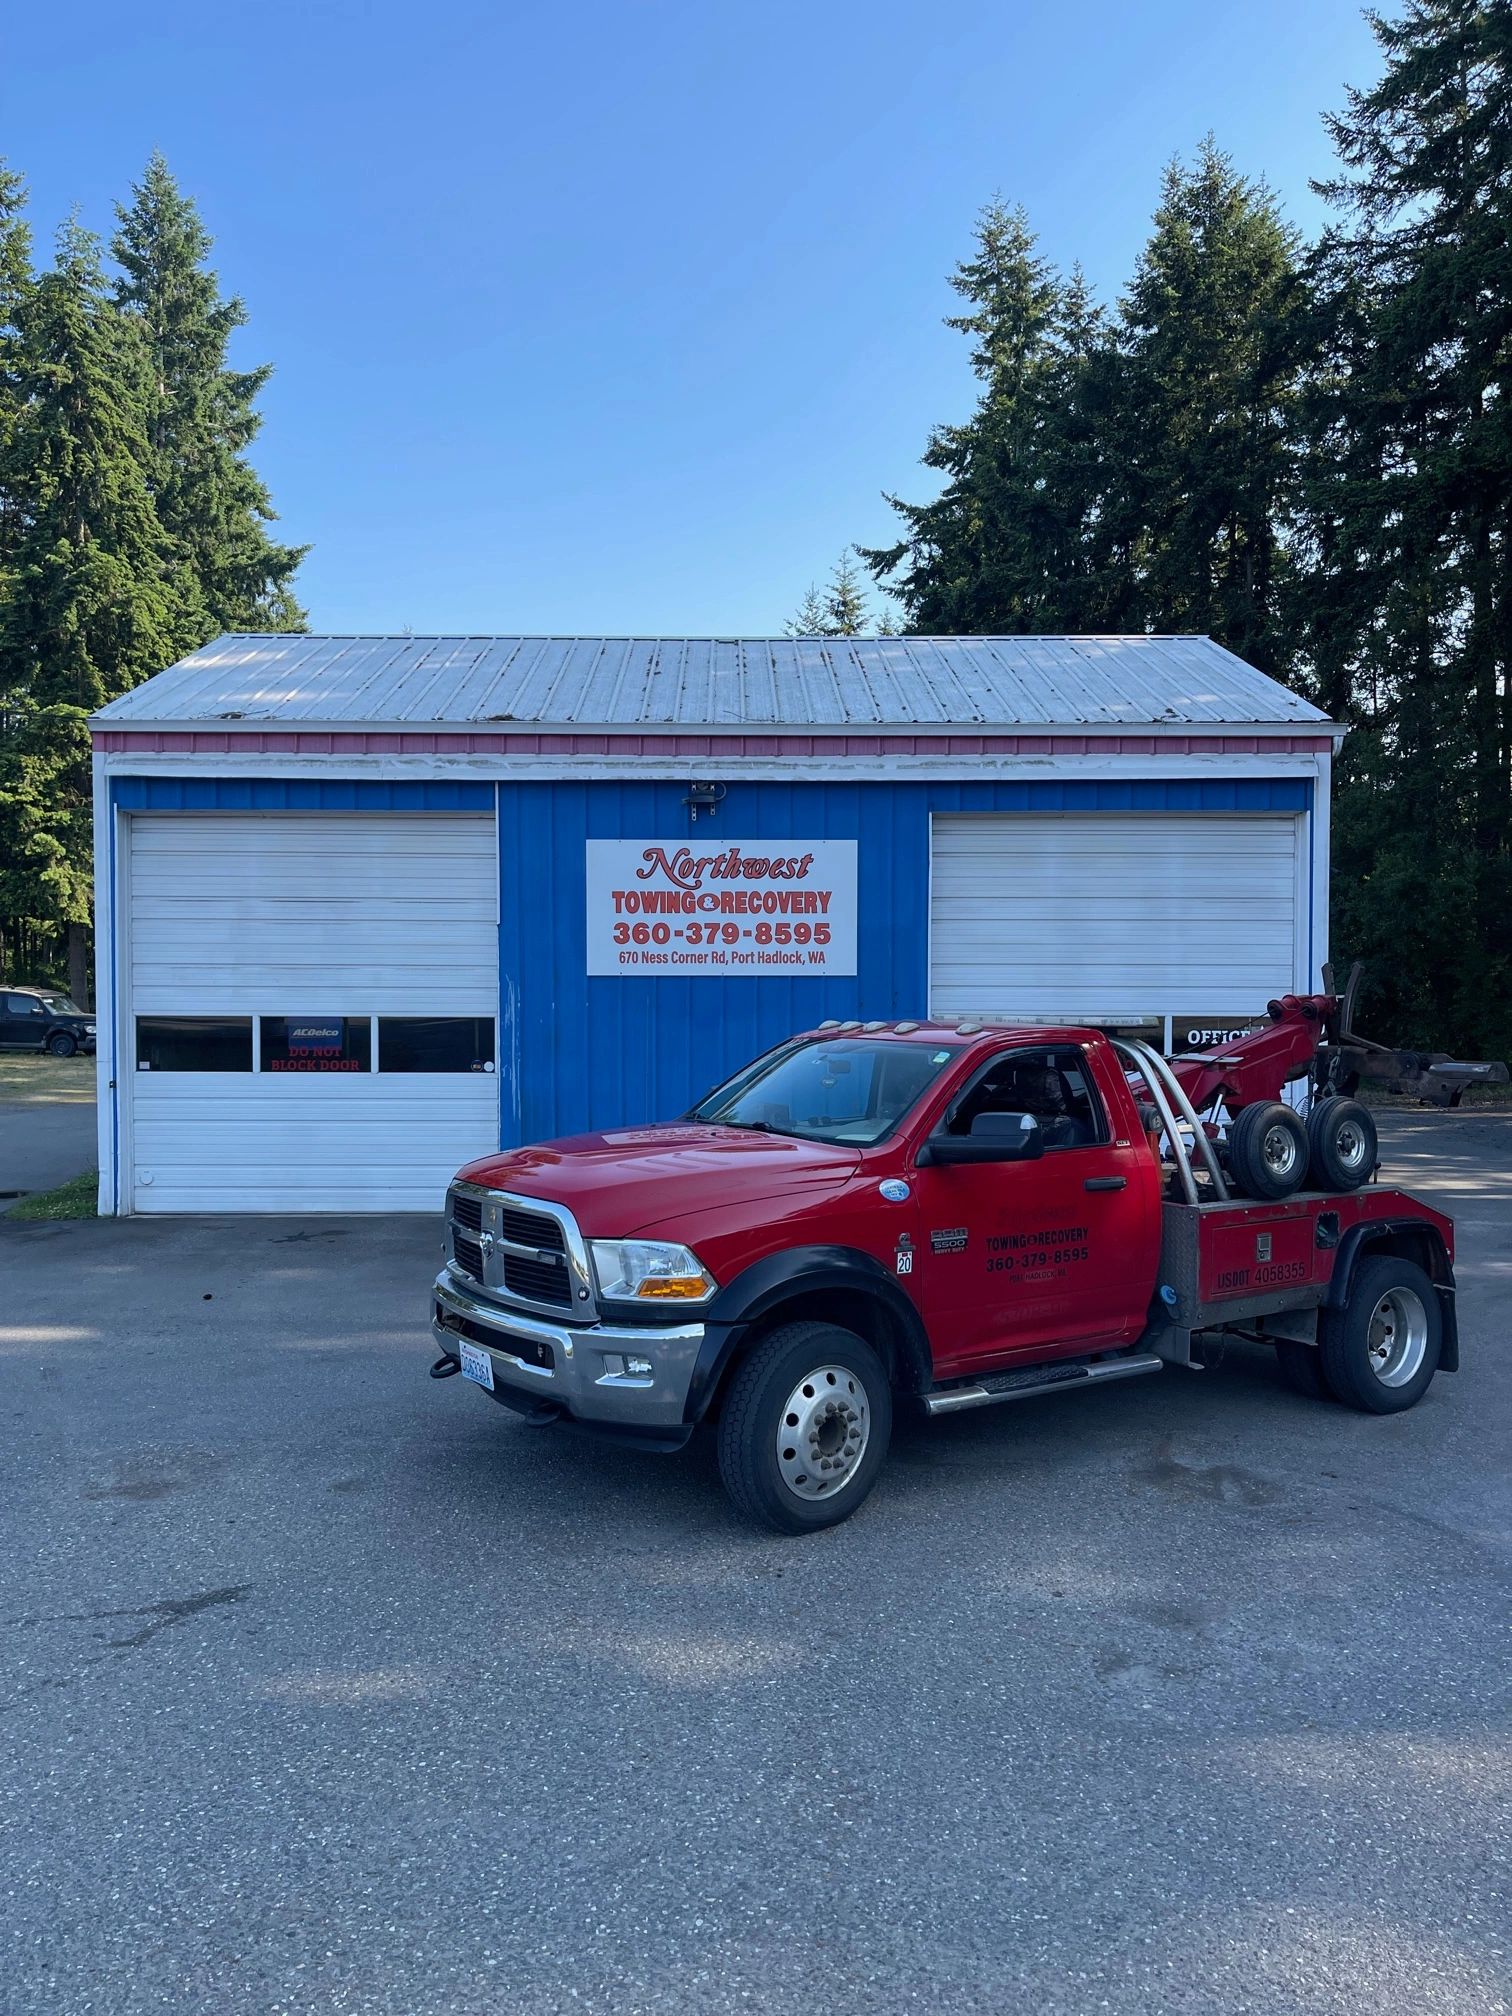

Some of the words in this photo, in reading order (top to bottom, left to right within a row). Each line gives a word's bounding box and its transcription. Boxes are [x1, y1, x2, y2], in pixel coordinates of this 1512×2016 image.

[636, 847, 814, 890] Northwest
[612, 891, 696, 914] TOWING
[720, 891, 832, 914] RECOVERY
[613, 922, 832, 945] 360-379-8595
[619, 951, 638, 964] 670
[641, 951, 668, 964] Ness
[671, 951, 708, 964] Corner
[711, 951, 728, 966] Rd,
[731, 951, 754, 964] Port
[757, 951, 805, 966] Hadlock,
[808, 951, 825, 964] WA
[293, 1028, 339, 1037] ACDelco
[289, 1047, 308, 1056] DO
[313, 1047, 340, 1056] NOT
[272, 1060, 316, 1070] BLOCK
[320, 1060, 359, 1070] DOOR
[934, 1240, 965, 1249] 5500
[986, 1233, 1027, 1252] TOWING
[1038, 1227, 1088, 1246] RECOVERY
[898, 1257, 911, 1273] 20
[986, 1247, 1088, 1273] 360-379-8595
[1217, 1269, 1250, 1288] USDOT
[1255, 1262, 1305, 1283] 4058355
